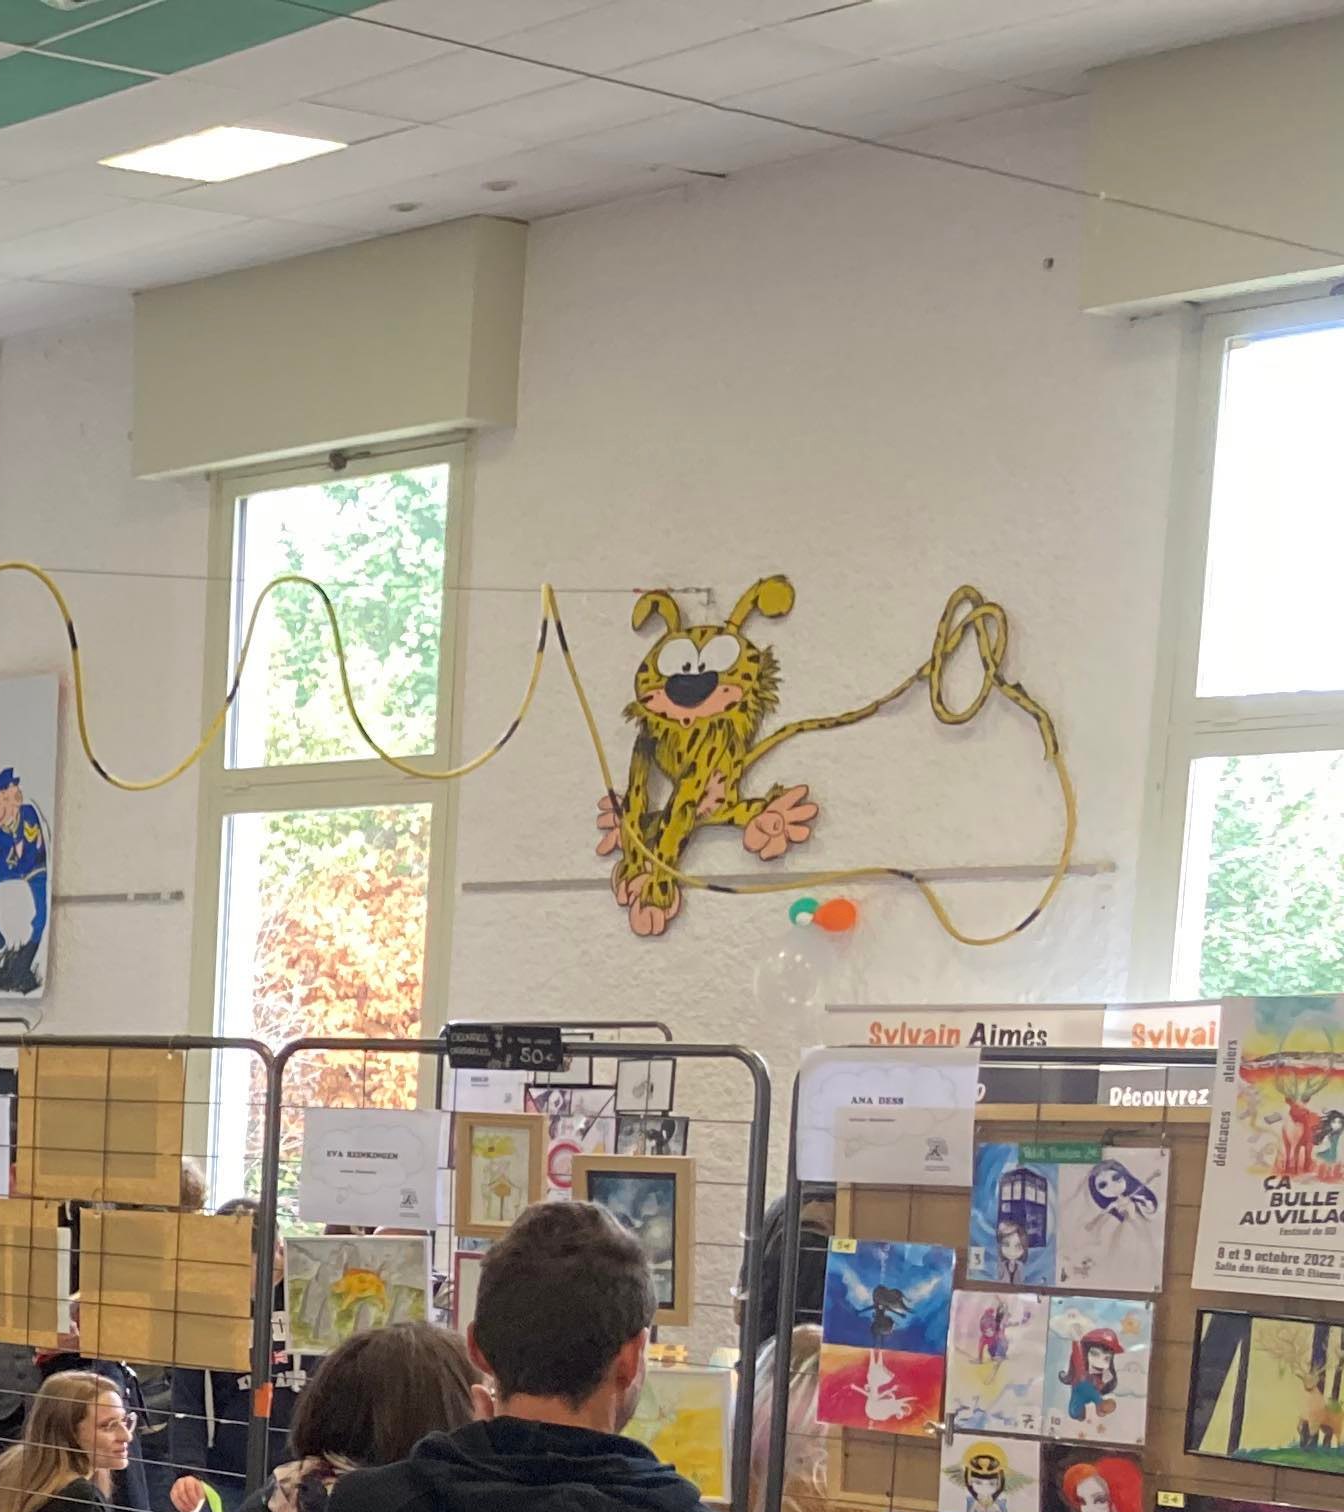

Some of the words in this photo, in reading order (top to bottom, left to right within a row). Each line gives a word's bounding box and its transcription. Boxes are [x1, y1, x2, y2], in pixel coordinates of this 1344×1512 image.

[868, 1021, 961, 1047] Sylvain
[969, 1021, 1049, 1047] Aimès
[1130, 1022, 1216, 1049] Sylvai
[1224, 1040, 1238, 1083] ateliers
[1109, 1086, 1210, 1107] Découvrez
[1213, 1110, 1231, 1167] dédicaces
[1269, 1191, 1340, 1208] BULLE
[1239, 1210, 1272, 1226] AU
[1217, 1246, 1226, 1260] 8
[1228, 1249, 1240, 1260] et
[1244, 1249, 1252, 1261] 9
[1255, 1251, 1300, 1265] octobre
[1304, 1253, 1335, 1268] 2022
[1215, 1261, 1237, 1272] Salle
[1239, 1264, 1254, 1273] des
[1282, 1267, 1293, 1276] de
